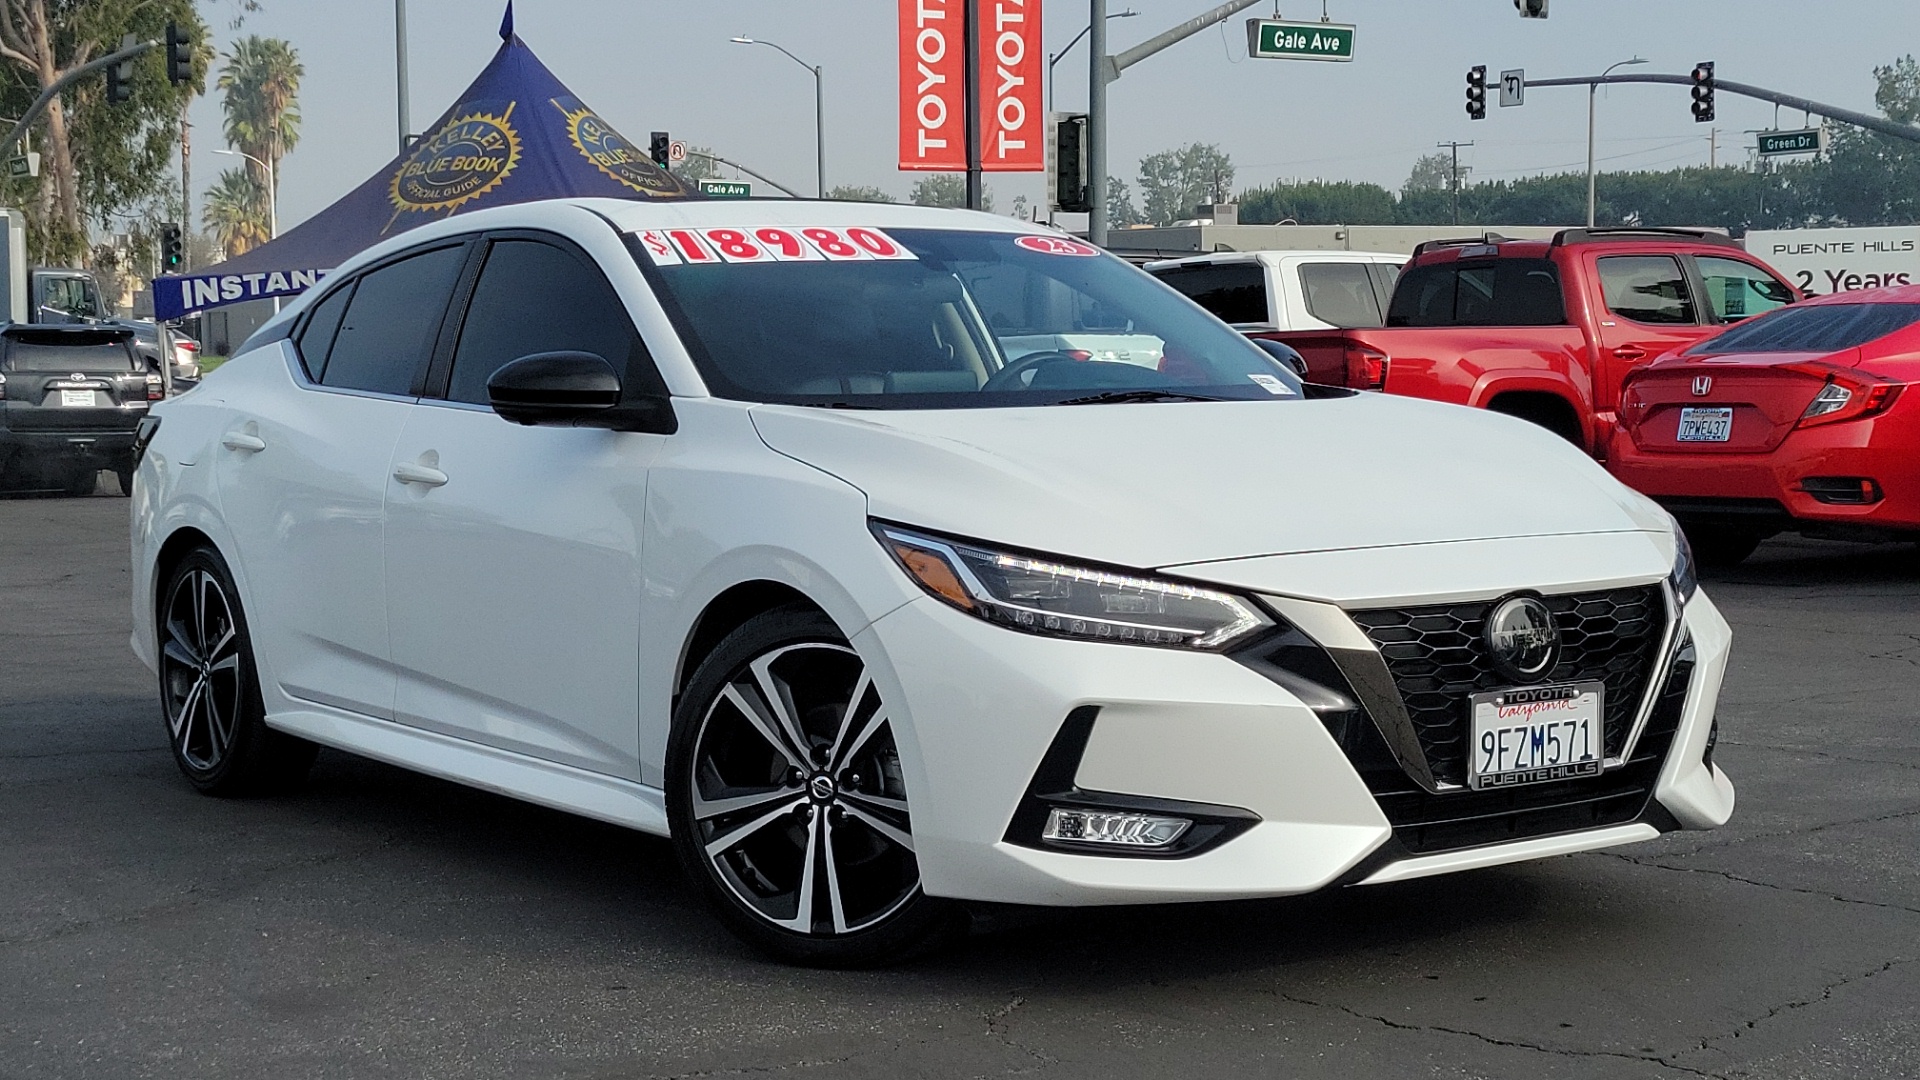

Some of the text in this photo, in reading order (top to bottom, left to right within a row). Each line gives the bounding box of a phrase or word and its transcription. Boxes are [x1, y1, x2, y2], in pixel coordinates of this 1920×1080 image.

[1274, 30, 1341, 51] Gale Ave
[916, 0, 947, 158] TOYOT
[996, 0, 1026, 159] TOYOT
[429, 124, 506, 154] KELLEY
[1767, 136, 1811, 150] Green Dr
[404, 155, 504, 177] BLUE BOOK
[592, 148, 632, 168] BLUE
[443, 176, 482, 197] GUIDE
[727, 184, 745, 195] Ave
[643, 227, 901, 262] $18980
[1037, 237, 1078, 254] 23
[1773, 240, 1915, 256] PUENTE HILLS
[1795, 269, 1911, 294] 2 Years
[1682, 420, 1728, 436] 7PWE437
[1505, 687, 1573, 703] TOYOTA
[1481, 718, 1593, 774] 9FZM571
[1480, 762, 1597, 788] PUENTE HILLS
